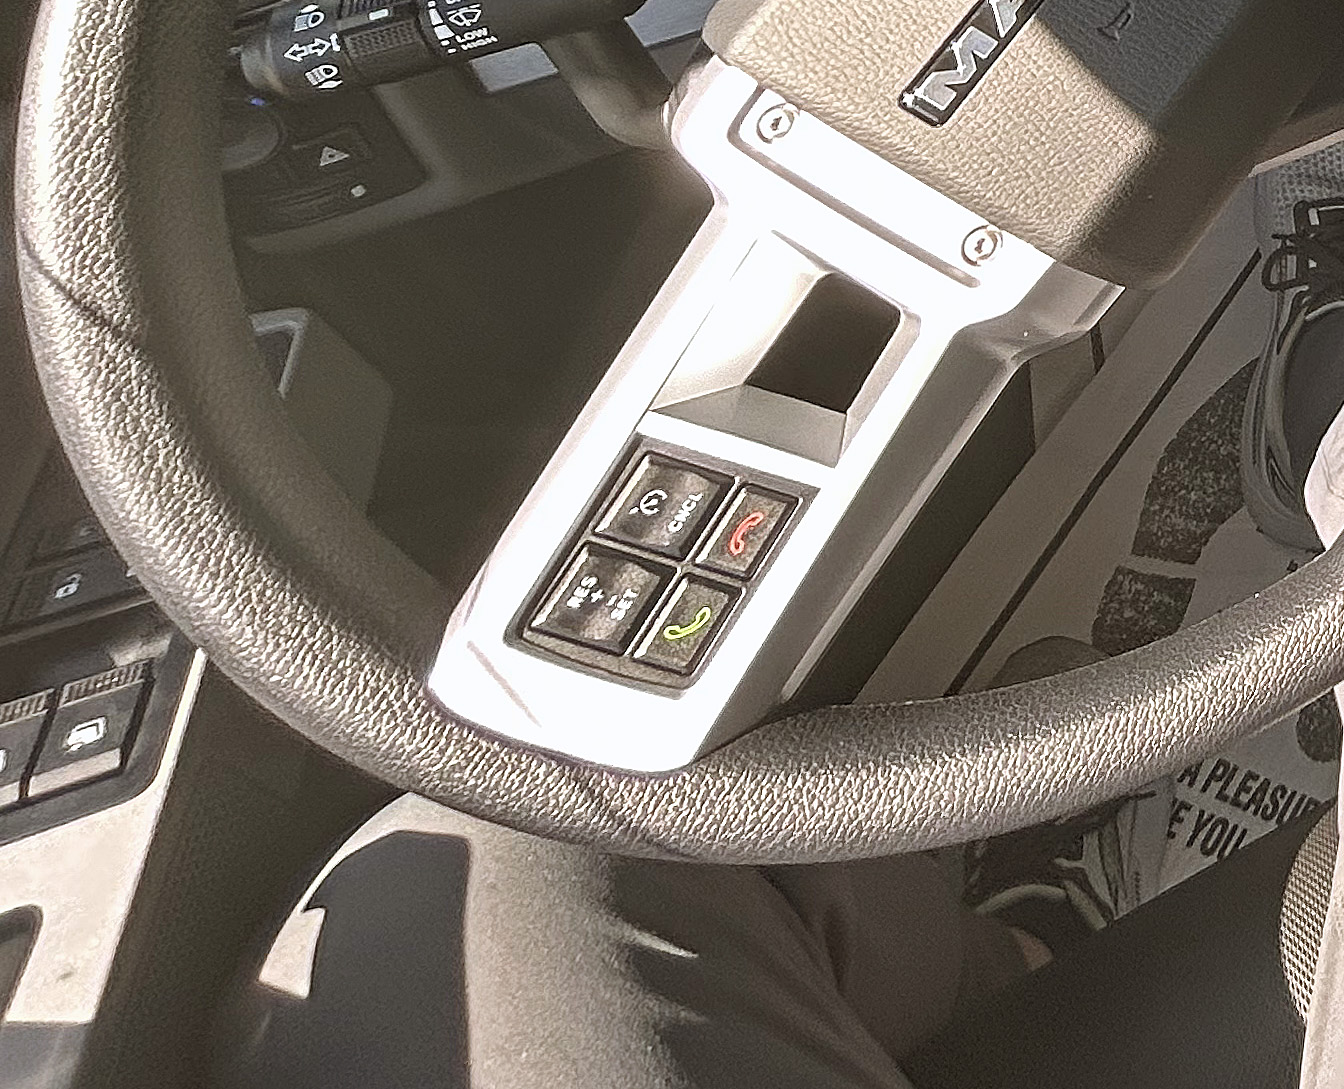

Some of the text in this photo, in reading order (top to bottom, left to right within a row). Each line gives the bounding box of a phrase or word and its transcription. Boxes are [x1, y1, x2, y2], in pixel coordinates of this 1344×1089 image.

[456, 28, 487, 42] LOW
[668, 493, 703, 533] CNCL
[611, 590, 639, 621] SET
[1186, 809, 1248, 860] YOU
